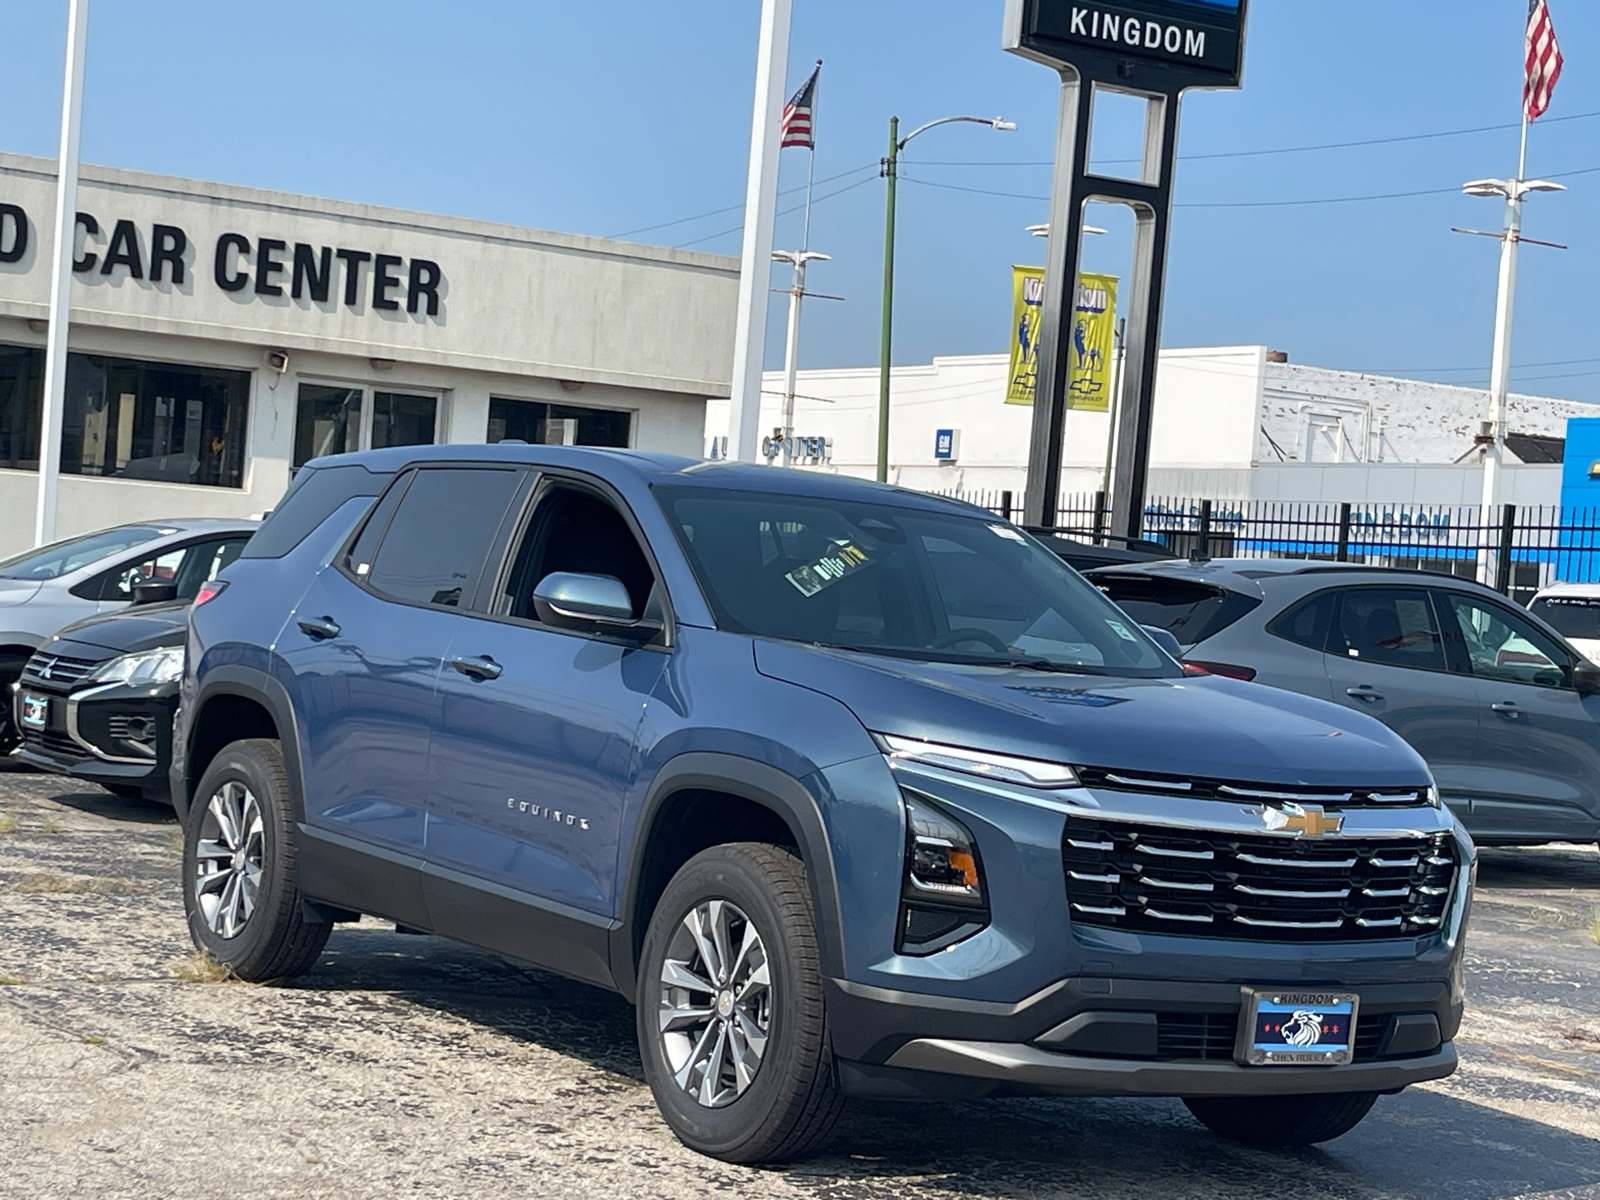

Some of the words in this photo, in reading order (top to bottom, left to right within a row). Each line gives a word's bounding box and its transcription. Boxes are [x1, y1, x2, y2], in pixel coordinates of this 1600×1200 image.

[1070, 7, 1205, 58] KINGDOM
[72, 211, 184, 284] CAR
[214, 232, 441, 316] CENTER
[507, 797, 590, 830] EQUINOX
[1279, 993, 1333, 1005] KINGDOM
[1271, 1052, 1326, 1062] CHEVROLET
